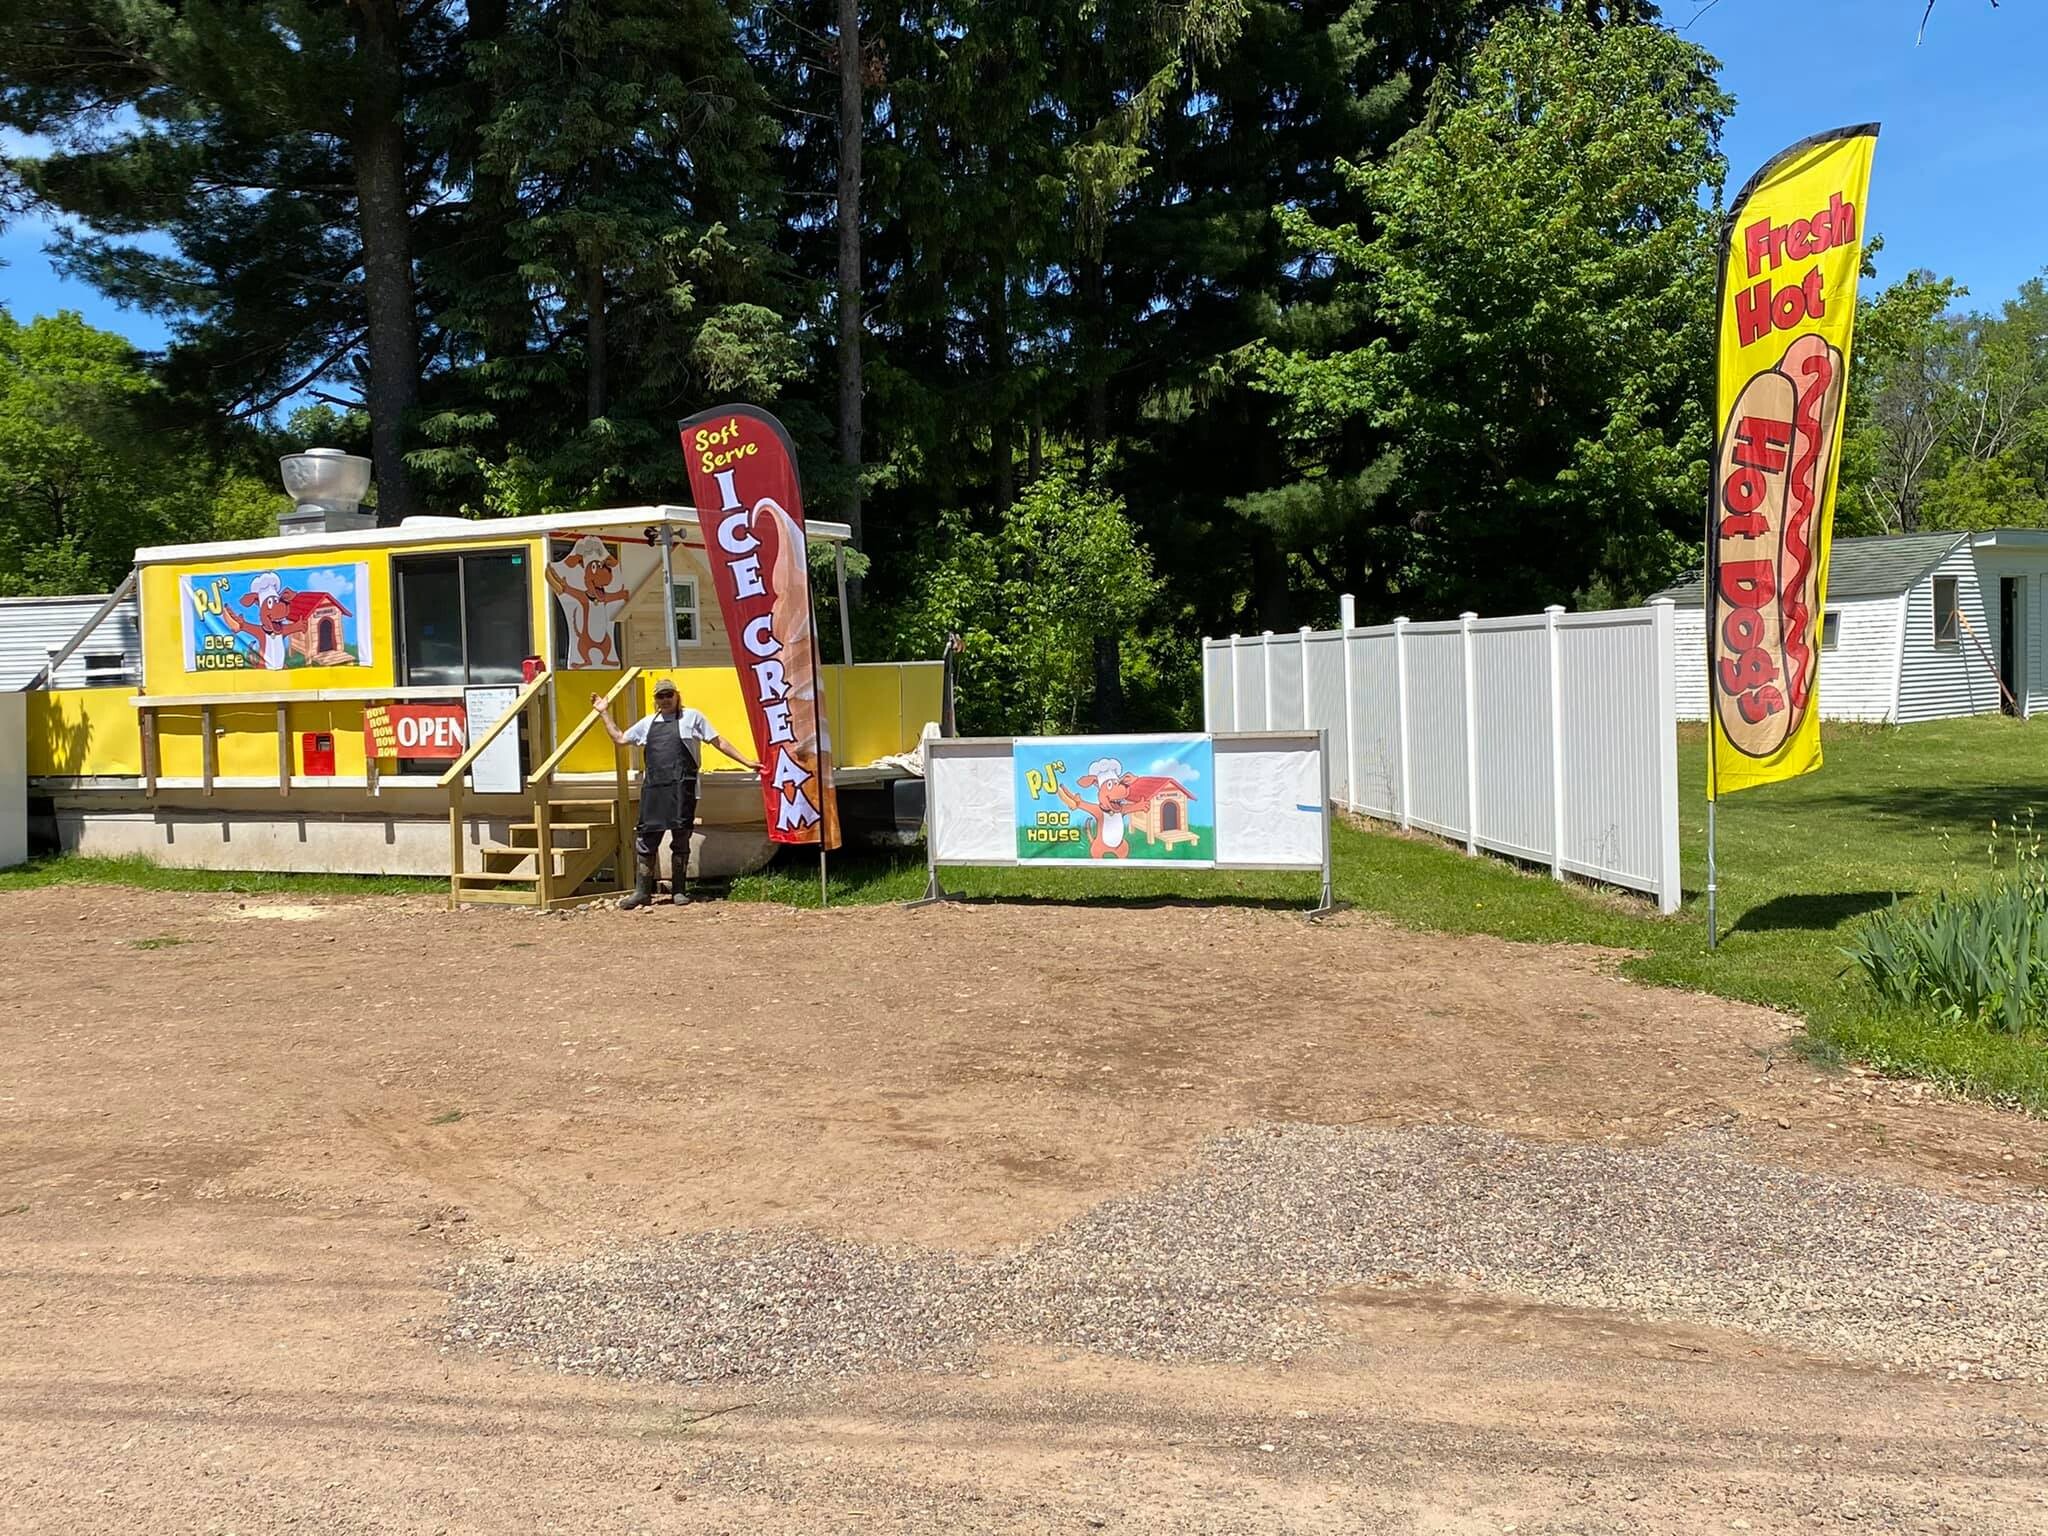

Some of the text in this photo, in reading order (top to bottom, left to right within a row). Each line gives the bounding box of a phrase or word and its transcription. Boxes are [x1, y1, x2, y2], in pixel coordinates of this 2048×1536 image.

[1744, 191, 1856, 279] Fresh
[1735, 265, 1825, 348] Hot
[695, 418, 739, 452] Soft
[702, 443, 759, 473] Serve
[1717, 416, 1793, 725] Hot Dogs
[204, 634, 235, 651] DOG
[713, 469, 821, 832] ICE CREAM
[196, 653, 244, 670] HOUSE
[366, 706, 386, 719] now
[369, 715, 390, 728] now
[373, 726, 394, 738] now
[397, 717, 467, 748] OPEN
[375, 736, 396, 748] now
[378, 747, 398, 758] now
[1036, 811, 1070, 827] DOG
[1027, 828, 1080, 842] HOUSE
